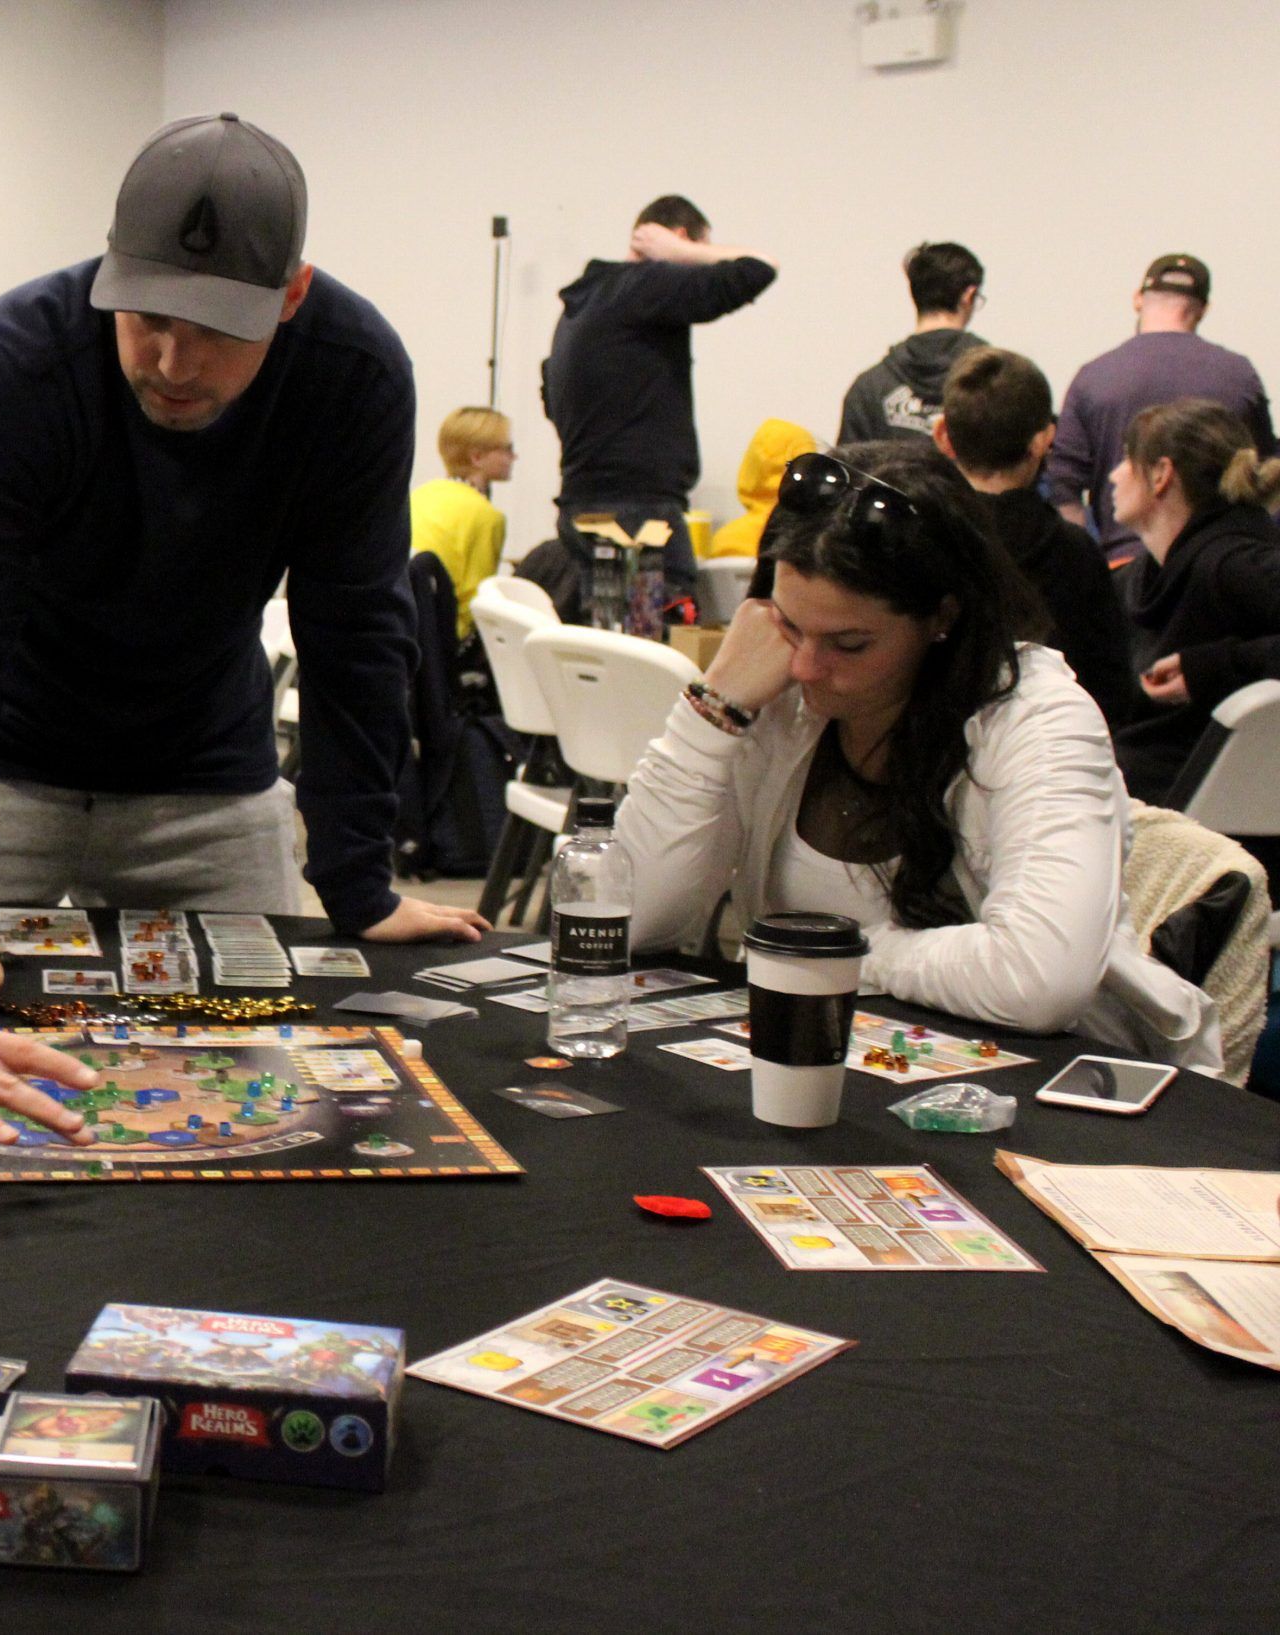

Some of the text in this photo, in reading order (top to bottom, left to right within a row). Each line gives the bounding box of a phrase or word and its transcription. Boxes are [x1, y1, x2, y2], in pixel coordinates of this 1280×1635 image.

[568, 926, 624, 938] AVENUE
[579, 941, 615, 950] COFFEE
[211, 1319, 286, 1336] REALMS
[227, 1316, 276, 1329] HERO
[203, 1402, 248, 1421] HERO
[190, 1413, 259, 1437] REALMS
